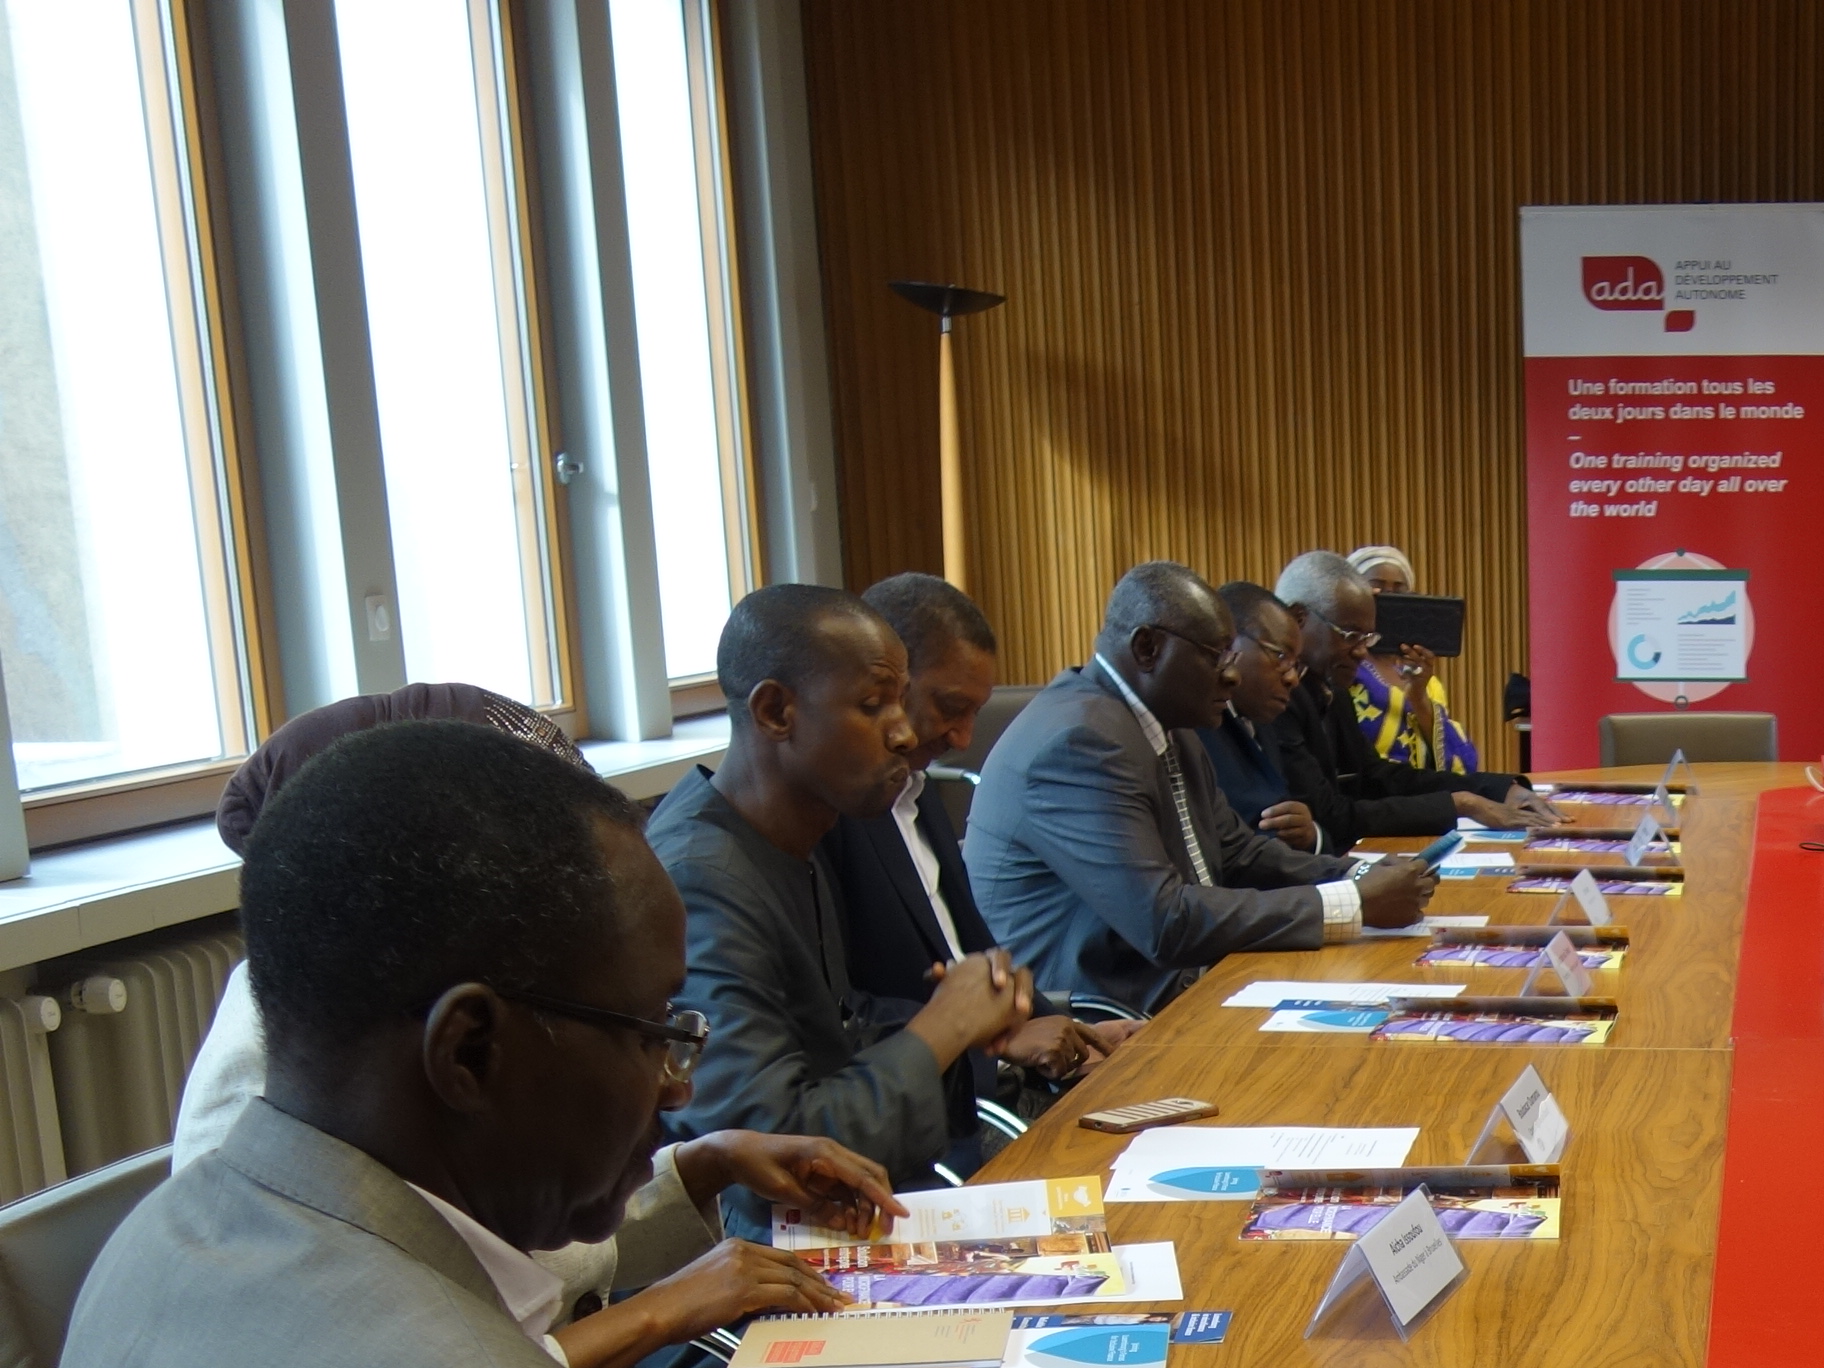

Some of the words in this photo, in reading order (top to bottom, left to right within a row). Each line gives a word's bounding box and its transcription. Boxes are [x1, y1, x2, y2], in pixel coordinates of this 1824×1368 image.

[1674, 260, 1711, 271] APPUI
[1713, 260, 1732, 271] AU
[1590, 266, 1665, 301] ada
[1674, 273, 1779, 286] DÉVELOPPEMENT
[1674, 289, 1746, 300] AUTONOME
[1567, 379, 1605, 395] Une
[1608, 378, 1698, 395] formation
[1701, 379, 1744, 394] tous
[1747, 378, 1775, 394] les
[1567, 403, 1614, 420] deux
[1615, 403, 1666, 424] jours
[1669, 403, 1715, 419] dans
[1719, 403, 1737, 419] le
[1740, 403, 1805, 419] monde
[1569, 452, 1608, 469] One
[1611, 452, 1685, 473] training
[1688, 451, 1783, 473] organized
[1568, 478, 1622, 497] every
[1624, 476, 1676, 493] other
[1678, 476, 1714, 497] day
[1716, 476, 1741, 493] all
[1743, 478, 1789, 493] over
[1569, 501, 1601, 517] the
[1603, 500, 1658, 517] world
